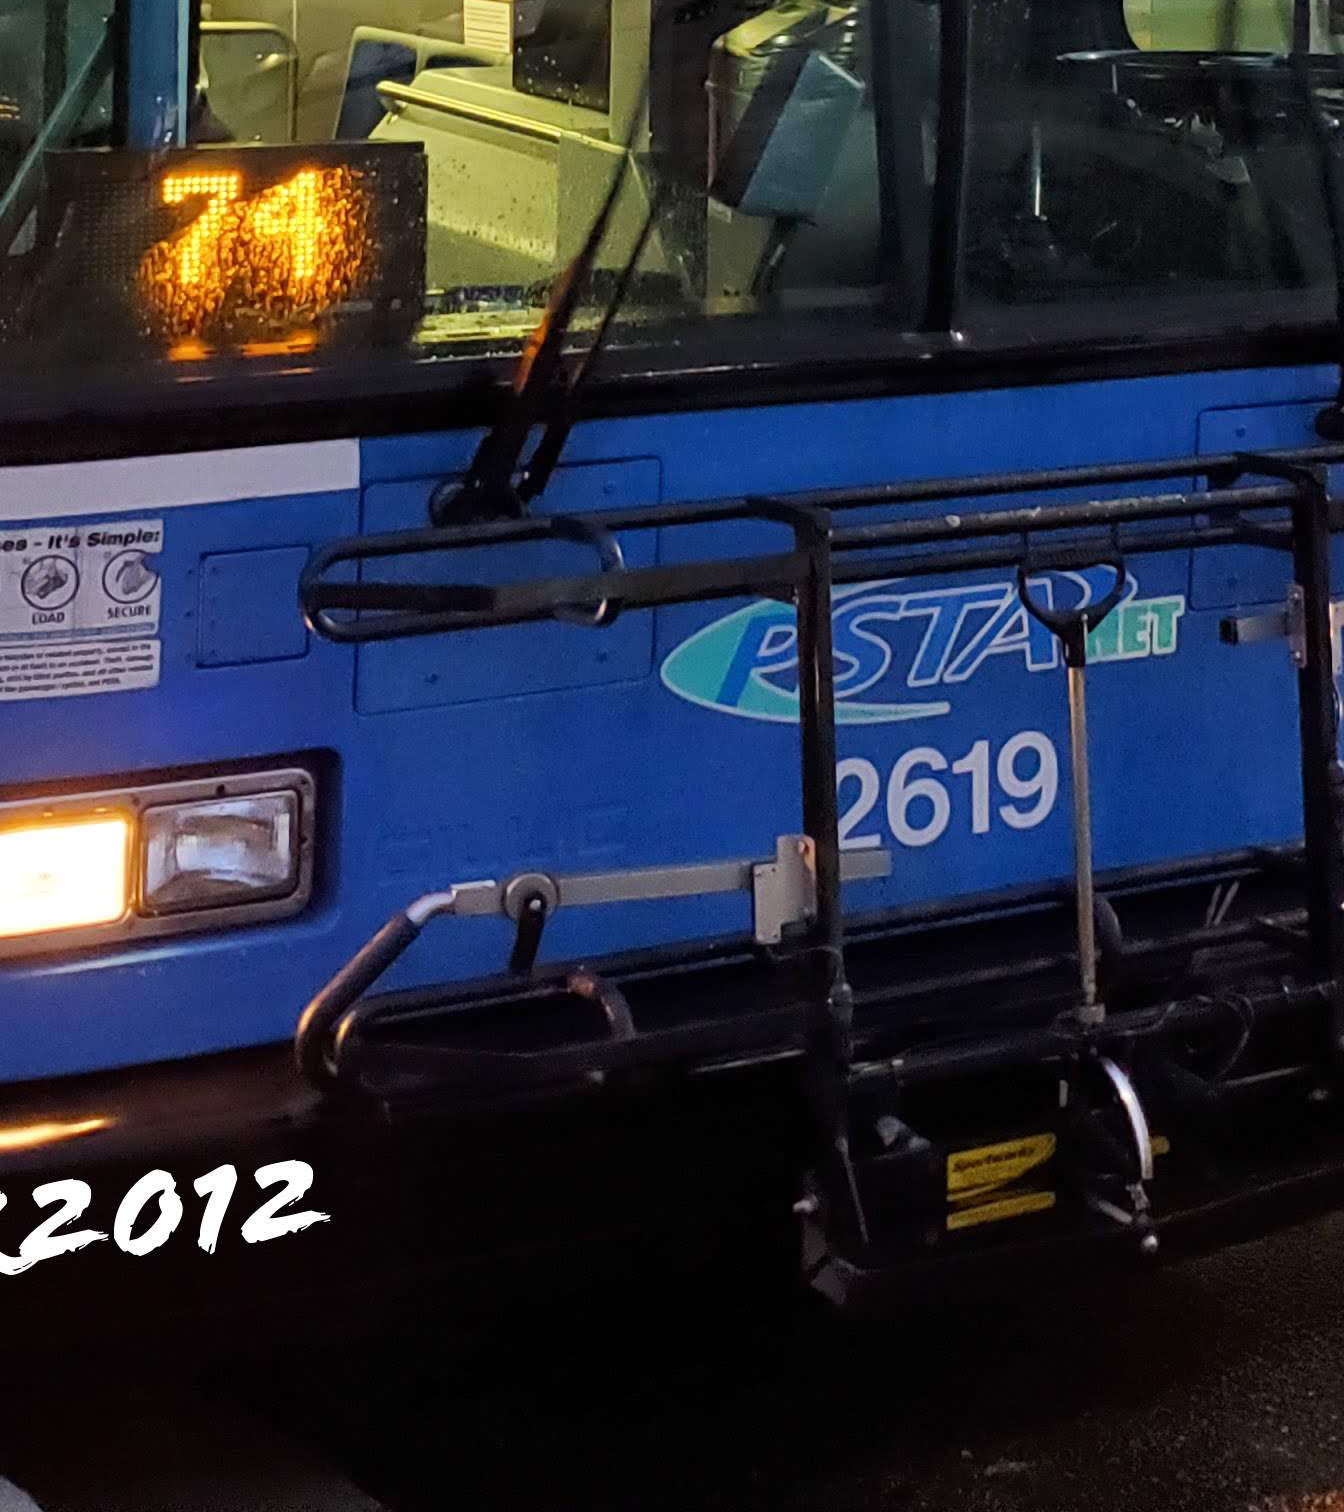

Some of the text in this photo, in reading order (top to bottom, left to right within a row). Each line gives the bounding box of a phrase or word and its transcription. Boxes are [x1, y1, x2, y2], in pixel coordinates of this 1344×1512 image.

[162, 170, 325, 284] 74
[47, 533, 82, 550] It's
[31, 610, 66, 626] LOAD
[107, 604, 153, 619] SECURE
[838, 730, 1060, 851] 2619
